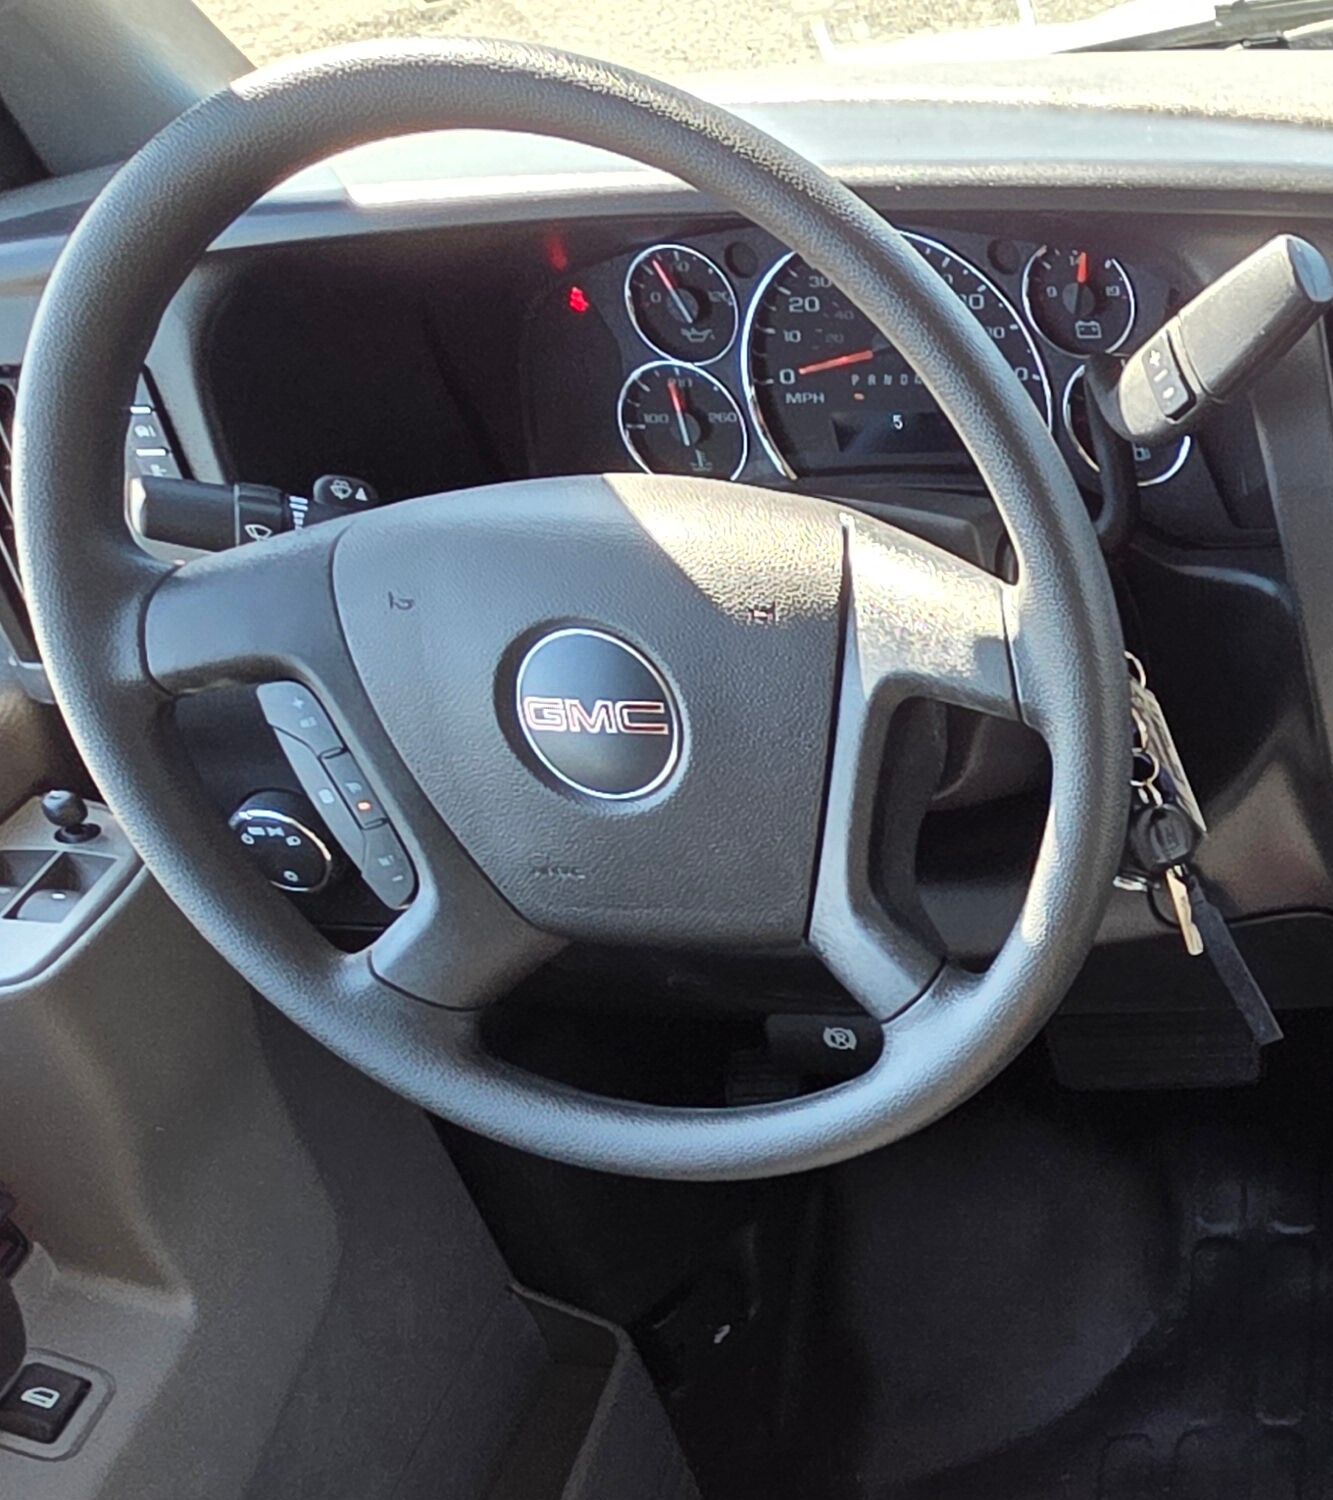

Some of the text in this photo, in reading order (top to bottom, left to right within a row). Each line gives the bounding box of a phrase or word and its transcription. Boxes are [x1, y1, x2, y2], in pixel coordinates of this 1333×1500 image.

[788, 296, 821, 313] 20
[784, 330, 801, 343] 10
[779, 368, 796, 385] 0
[785, 392, 825, 404] MPH
[892, 414, 904, 430] 5
[523, 696, 669, 735] GMC
